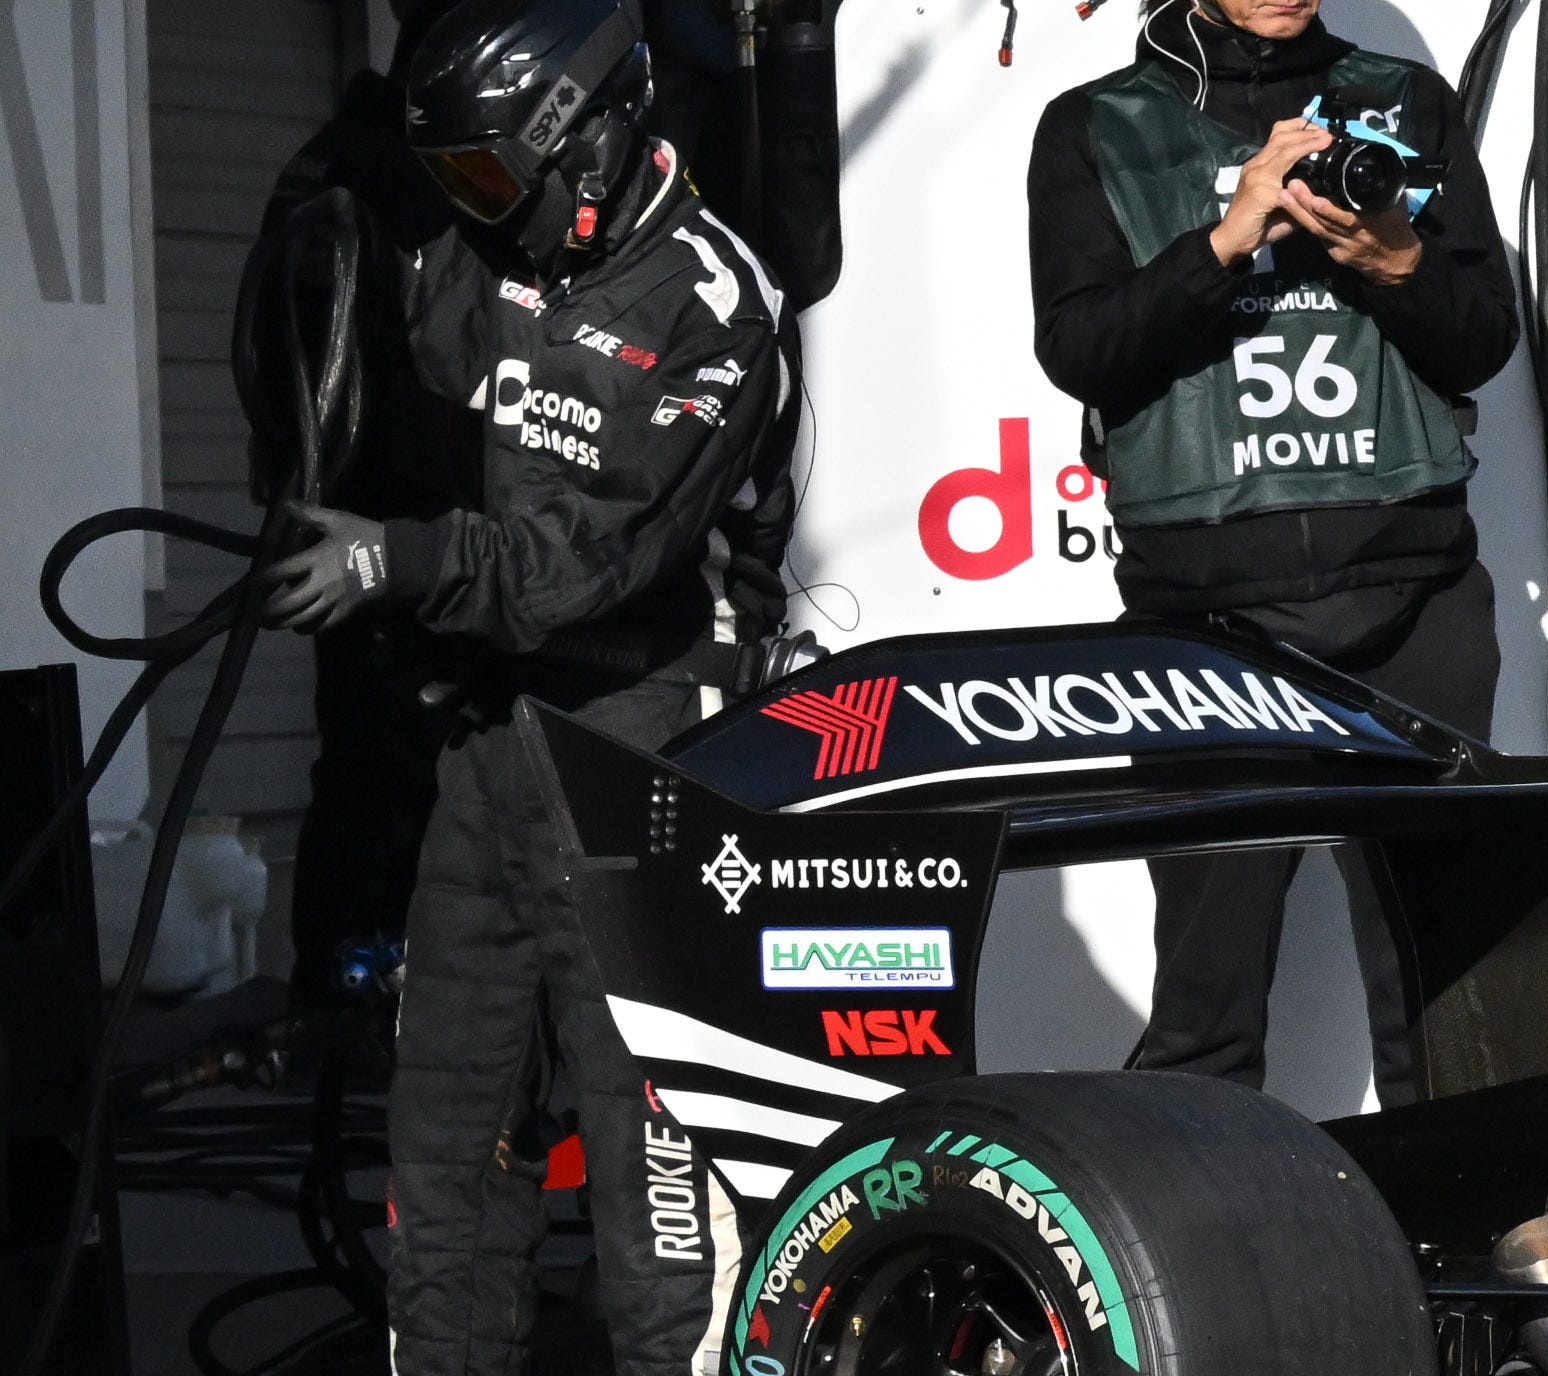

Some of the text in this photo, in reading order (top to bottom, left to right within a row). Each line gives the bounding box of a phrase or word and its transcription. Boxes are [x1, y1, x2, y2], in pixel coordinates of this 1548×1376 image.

[1231, 290, 1338, 313] FORMULA
[1234, 335, 1359, 419] 56
[1233, 428, 1376, 476] MOVIE
[903, 668, 1350, 747] YOKOHAMA
[771, 941, 944, 970] HAYASHI
[846, 971, 943, 982] TELEMPU
[821, 1010, 951, 1057] NSK
[644, 1122, 703, 1264] ROOKIE
[863, 1160, 928, 1221] RR
[759, 1185, 860, 1305] YOKOHAMA
[968, 1167, 1108, 1331] ADVAN
